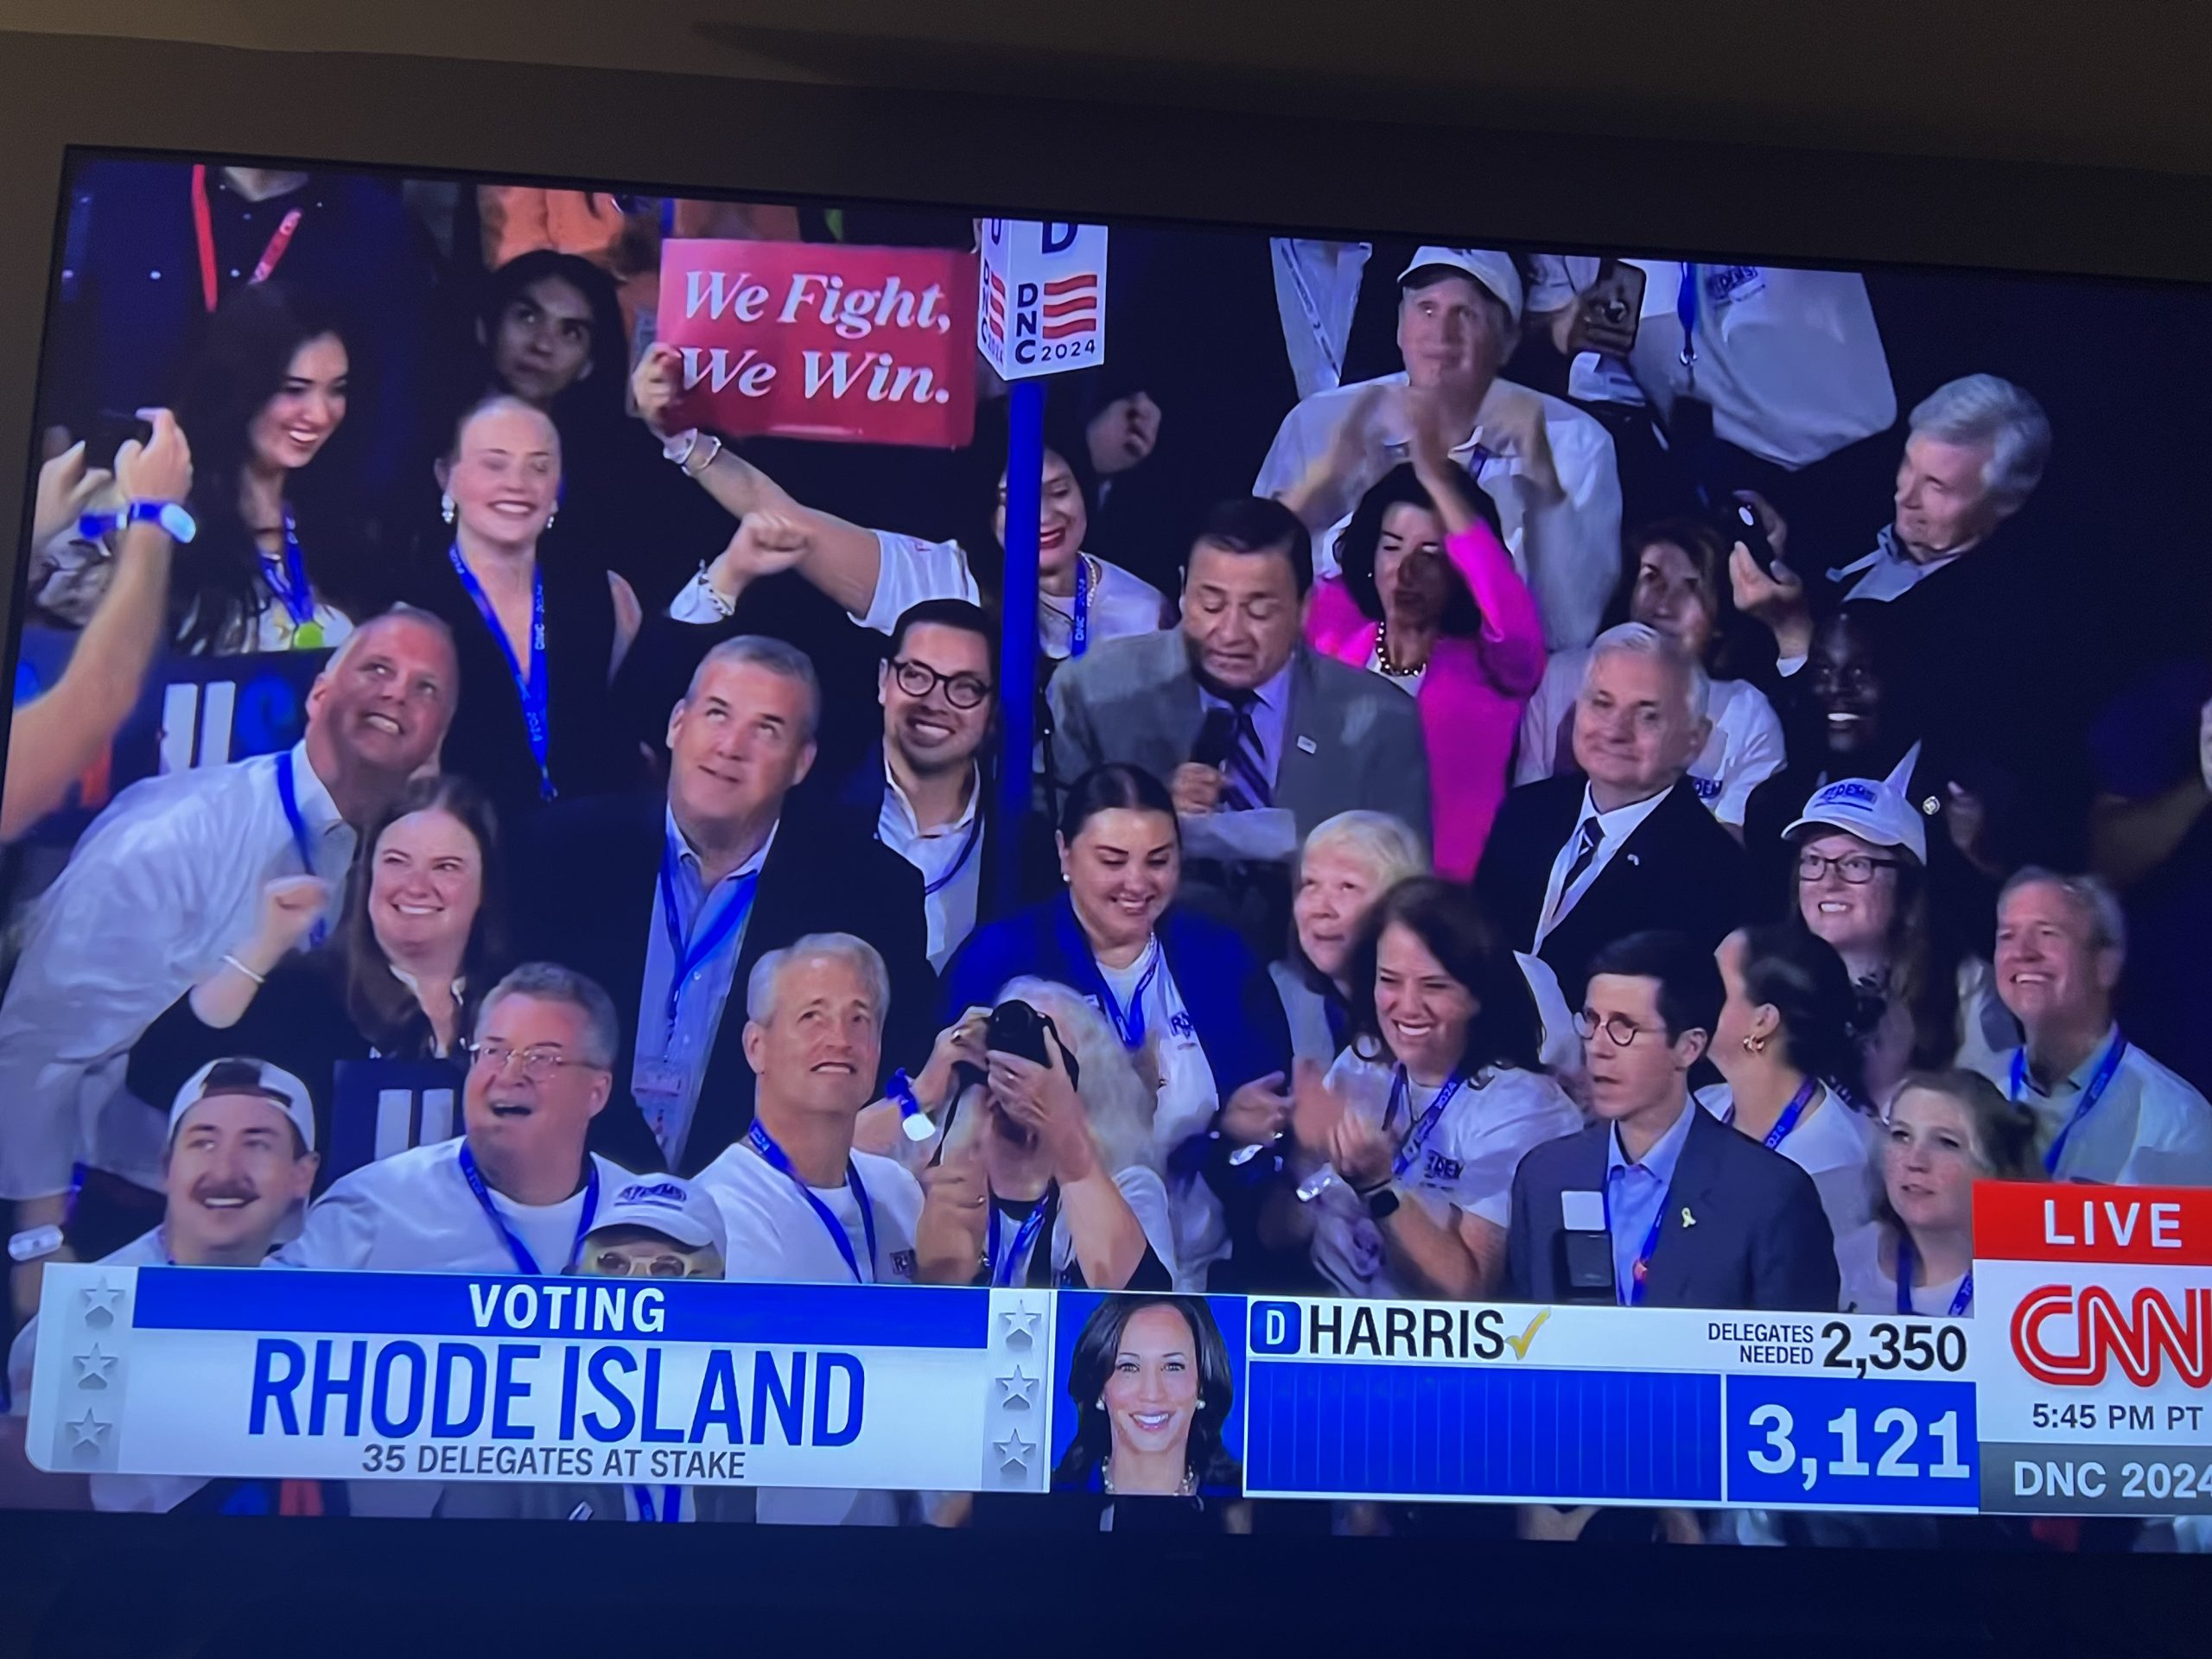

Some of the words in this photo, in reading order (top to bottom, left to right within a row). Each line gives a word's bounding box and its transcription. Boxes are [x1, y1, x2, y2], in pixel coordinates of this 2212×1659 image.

[684, 271, 769, 321] We
[778, 274, 951, 339] Fight,
[1015, 283, 1039, 365] DNC
[1040, 340, 1095, 361] 2024
[680, 347, 776, 397] We
[803, 351, 950, 404] Win.
[1075, 614, 1085, 641] DNC
[2044, 1199, 2183, 1249] LIVE
[468, 1283, 665, 1332] VOTING
[1265, 1309, 1287, 1345] D
[1309, 1304, 1504, 1360] HARRIS
[1707, 1322, 1815, 1344] DELEGATES
[1739, 1344, 1815, 1365] NEEDED
[1821, 1320, 1967, 1379] 2,350
[2010, 1283, 2212, 1389] CNN
[248, 1338, 542, 1440] RHODE
[558, 1345, 865, 1447] ISLAND
[2032, 1402, 2096, 1428] 5:45
[2108, 1405, 2155, 1430] PM
[2167, 1407, 2203, 1431] PT
[362, 1444, 405, 1471] 35
[418, 1446, 594, 1477] DELEGATES
[603, 1449, 643, 1477] AT
[651, 1450, 747, 1479] STAKE
[1748, 1404, 1970, 1491] 3,121
[2013, 1460, 2107, 1497] DNC
[2121, 1462, 2212, 1498] 2024
